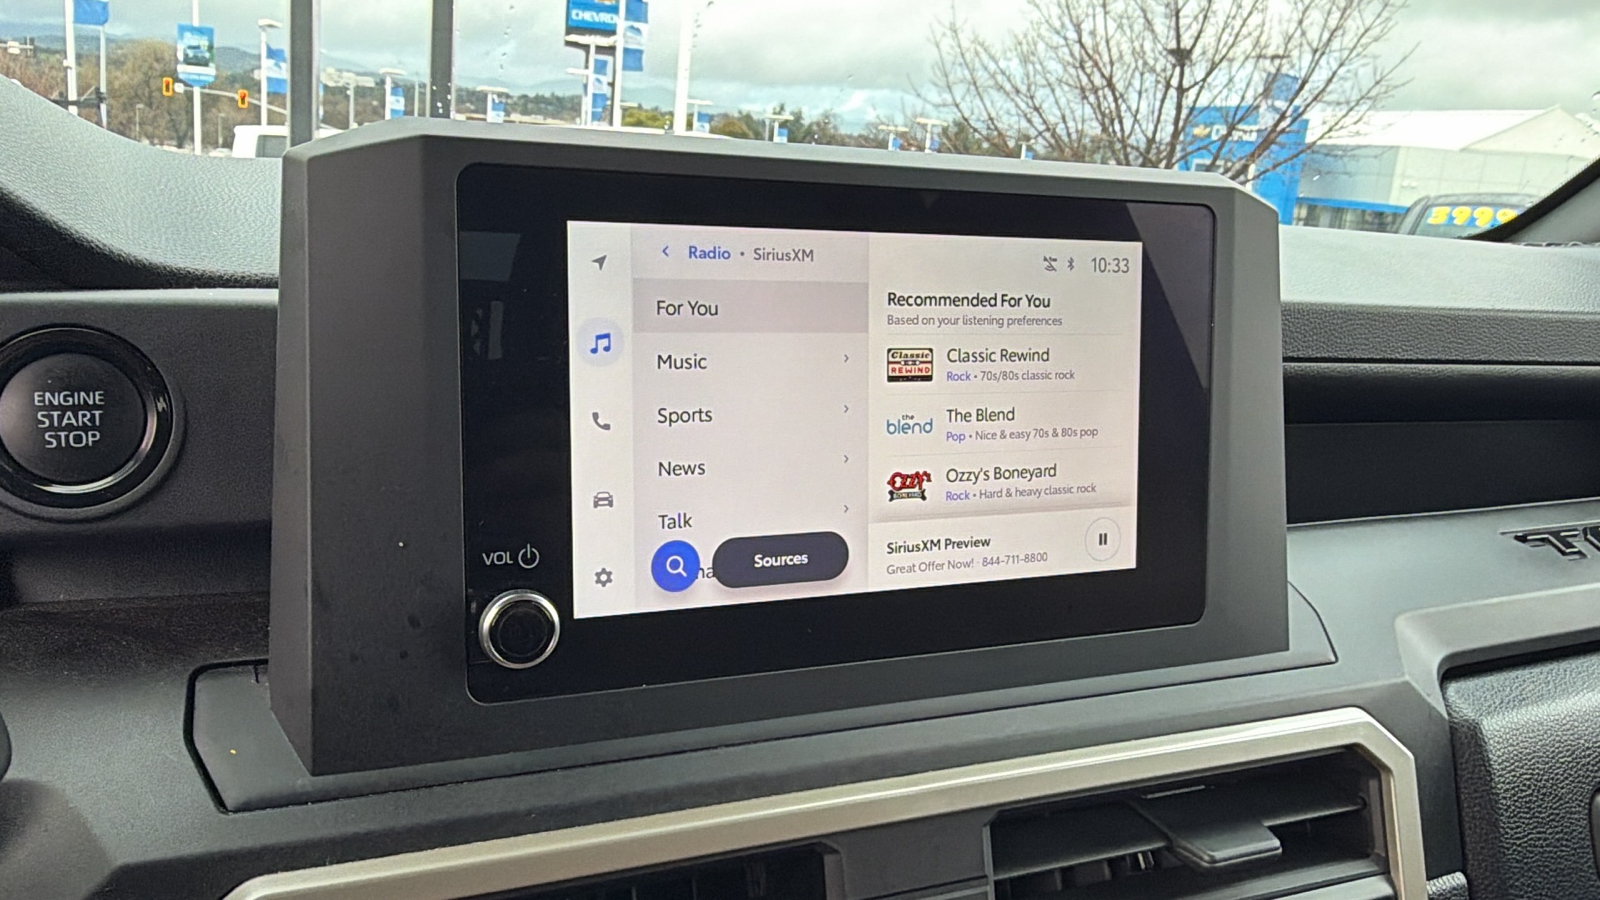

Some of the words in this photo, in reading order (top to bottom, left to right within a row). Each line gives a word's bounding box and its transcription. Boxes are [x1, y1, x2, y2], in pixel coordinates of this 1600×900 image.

[688, 245, 731, 260] Radio
[753, 248, 815, 262] SiriusXM
[1091, 257, 1130, 273] 10:33
[656, 300, 684, 316] For
[687, 300, 719, 316] You
[887, 292, 998, 307] Recommended
[1001, 293, 1023, 308] For
[1025, 294, 1051, 308] You
[887, 315, 919, 326] Based
[921, 317, 935, 326] on
[937, 317, 961, 328] your
[962, 315, 1005, 328] listening
[1006, 316, 1063, 328] preferences
[657, 353, 708, 370] Music
[891, 351, 930, 359] Classic
[946, 348, 996, 363] Classic
[1000, 348, 1050, 362] Rewind
[946, 370, 971, 381] Rock
[980, 370, 1019, 382] 70s/80s
[1021, 370, 1052, 380] classic
[1054, 370, 1075, 380] rock
[34, 391, 105, 406] ENGINE
[37, 410, 104, 428] START
[657, 408, 713, 427] Sports
[946, 408, 972, 423] The
[976, 407, 1015, 422] Blend
[886, 418, 933, 435] blend
[44, 431, 100, 448] STOP
[946, 432, 966, 443] Pop
[975, 429, 997, 441] Nice
[999, 430, 1007, 440] &
[1009, 430, 1031, 442] easy
[1032, 429, 1050, 439] 70s
[1051, 428, 1059, 438] &
[1061, 427, 1078, 438] 80s
[1079, 428, 1099, 439] pop
[658, 461, 706, 477] News
[946, 468, 990, 485] Ozzy's
[993, 463, 1057, 481] Boneyard
[946, 490, 971, 501] Rock
[979, 488, 1003, 500] Hard
[1005, 488, 1013, 498] &
[1014, 486, 1043, 499] heavy
[1044, 484, 1075, 496] classic
[1076, 483, 1097, 494] rock
[657, 512, 693, 529] Talk
[886, 539, 942, 554] SiriusXM
[944, 536, 992, 551] Preview
[482, 551, 514, 566] VOL
[754, 553, 809, 568] Sources
[886, 563, 917, 575] Great
[918, 560, 946, 573] Offer
[947, 558, 974, 570] Now!
[981, 552, 1048, 567] 844-711-8800
